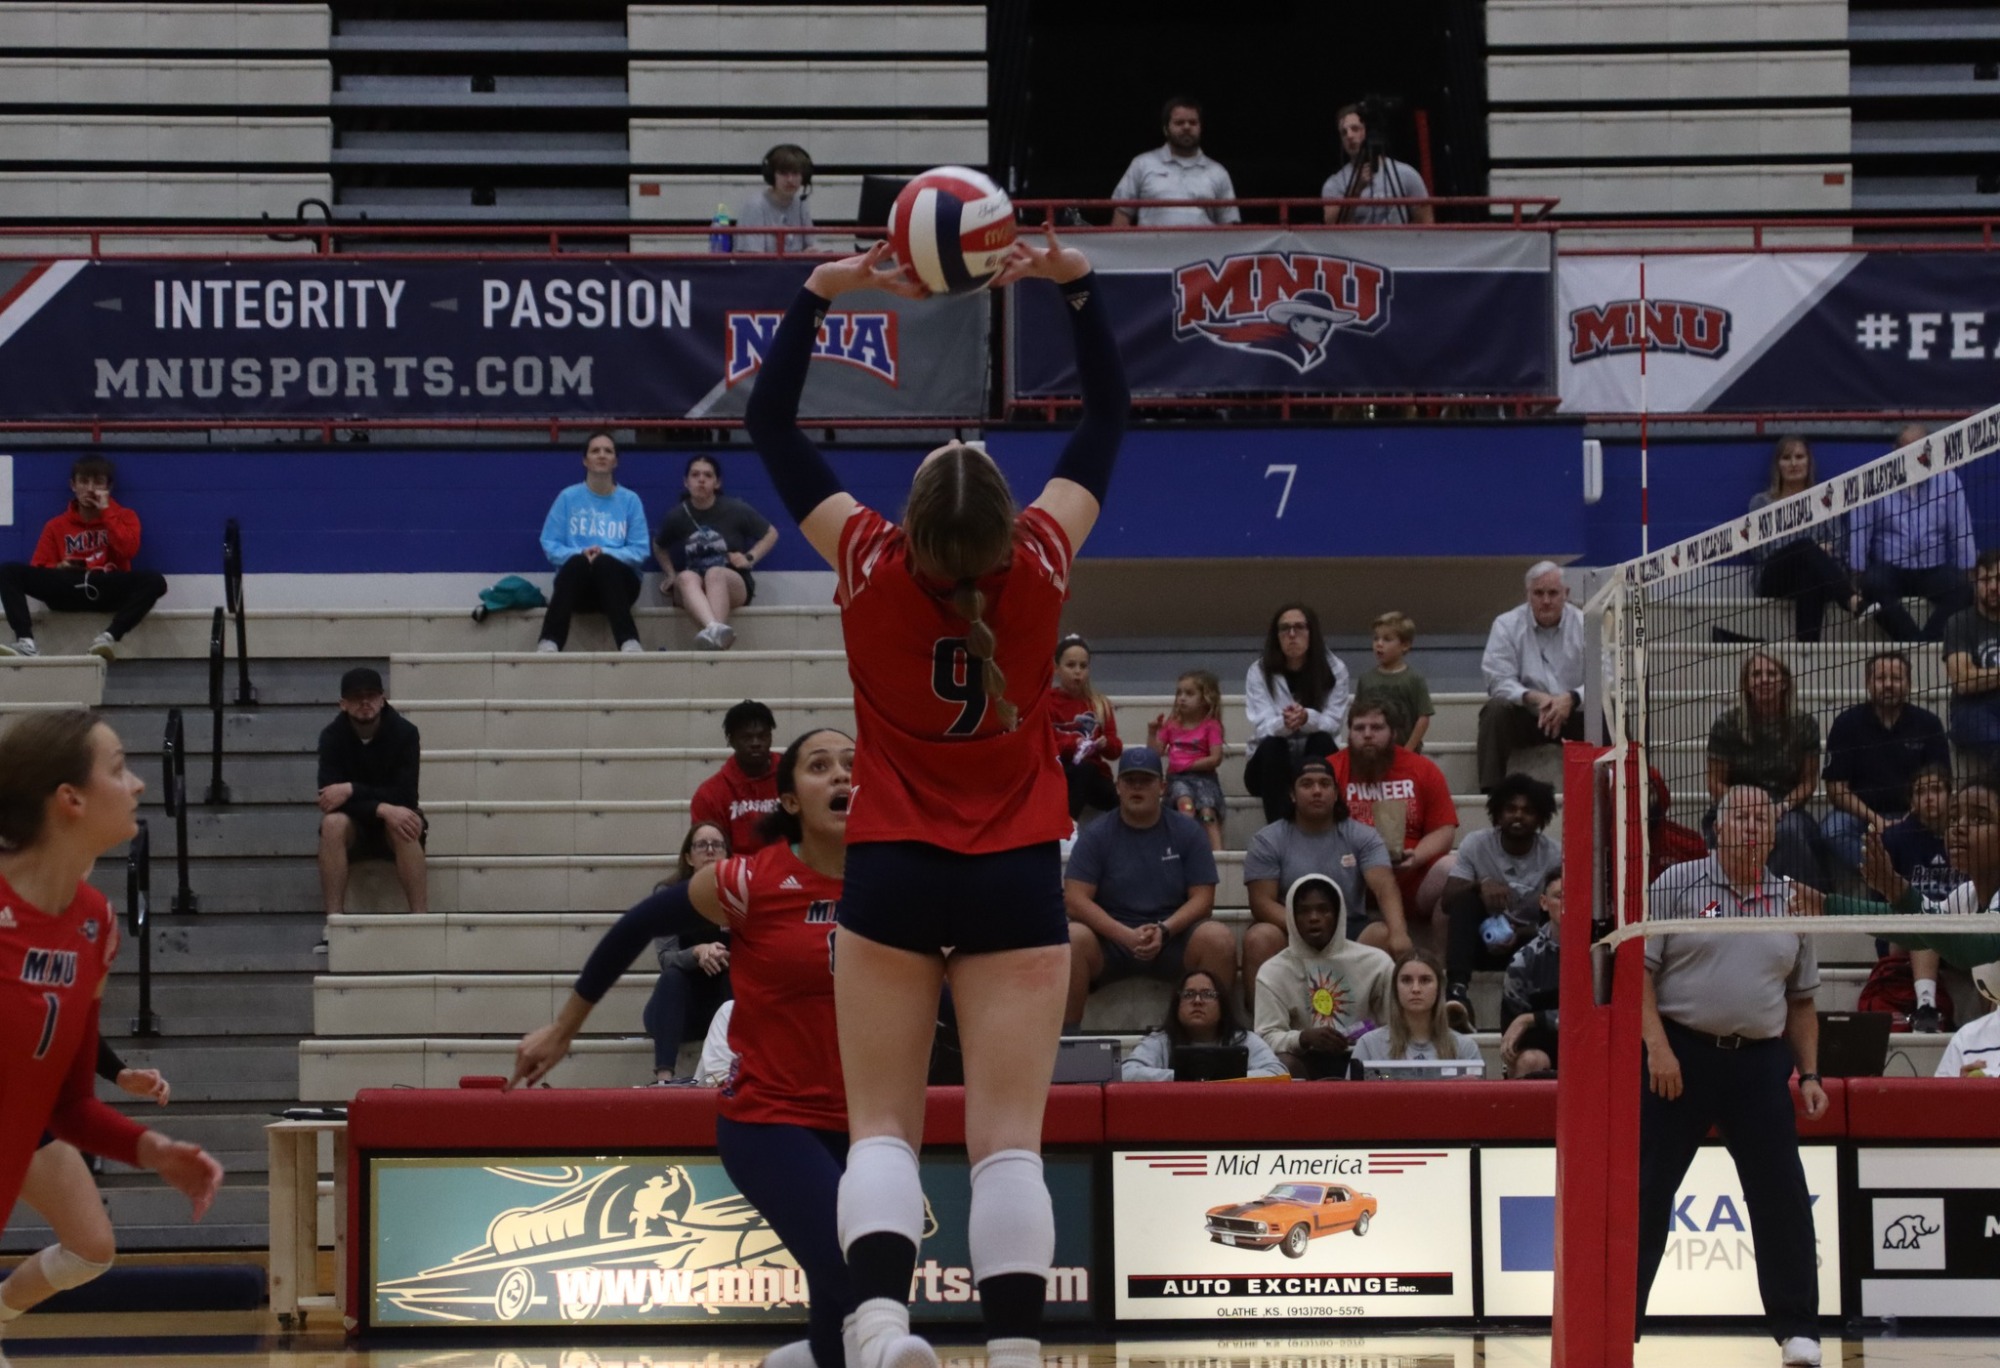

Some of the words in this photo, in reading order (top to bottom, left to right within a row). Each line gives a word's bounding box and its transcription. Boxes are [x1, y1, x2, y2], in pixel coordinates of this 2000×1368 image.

[154, 279, 405, 329] INTEGRITY
[482, 279, 691, 328] PASSION
[1176, 252, 1388, 332] MNU
[727, 312, 896, 384] NIA
[1570, 299, 1732, 364] MNU
[1857, 311, 2000, 359] #FE
[94, 356, 594, 399] MNUSPORTS.COM
[1264, 464, 1297, 518] 7
[570, 516, 627, 539] SEASON
[931, 637, 989, 735] 9
[20, 947, 78, 987] MNU
[1215, 1154, 1260, 1176] Mid
[1269, 1154, 1363, 1175] America
[1162, 1279, 1232, 1295] AUTO
[1247, 1278, 1399, 1294] EXCHANGE
[1217, 1307, 1258, 1317] OLATHE
[1286, 1306, 1365, 1317] (913)780-5576
